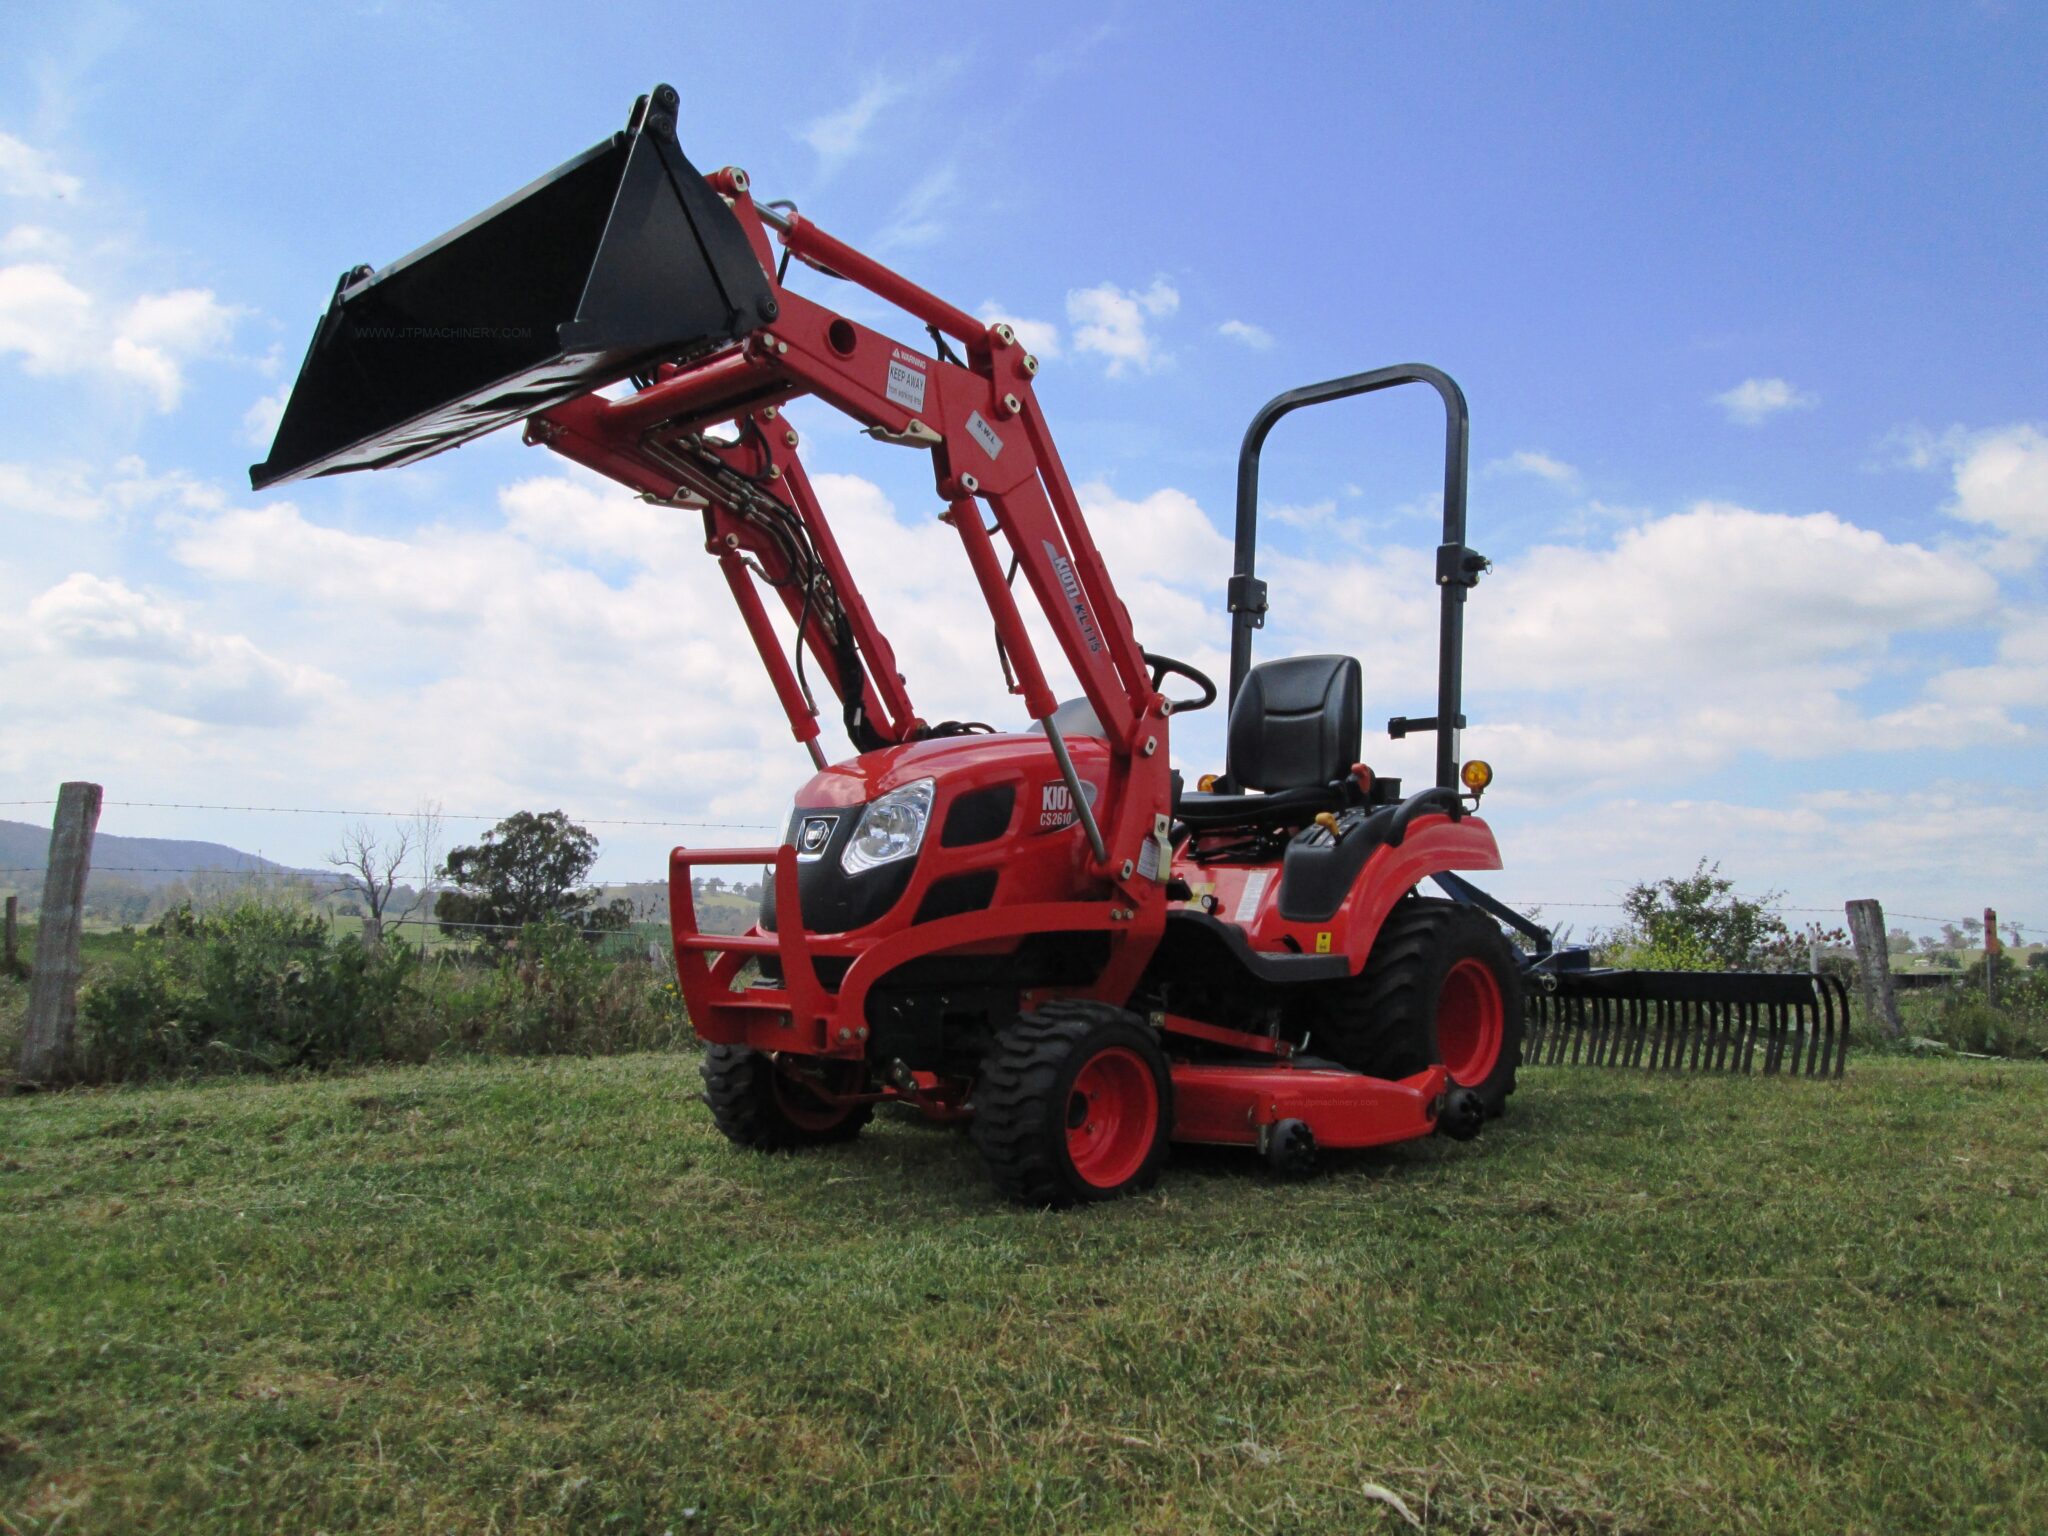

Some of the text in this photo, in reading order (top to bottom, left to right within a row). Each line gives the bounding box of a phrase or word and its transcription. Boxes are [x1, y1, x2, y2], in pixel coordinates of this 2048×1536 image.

[901, 351, 926, 370] WARNING
[889, 366, 923, 391] KEEP AWAY
